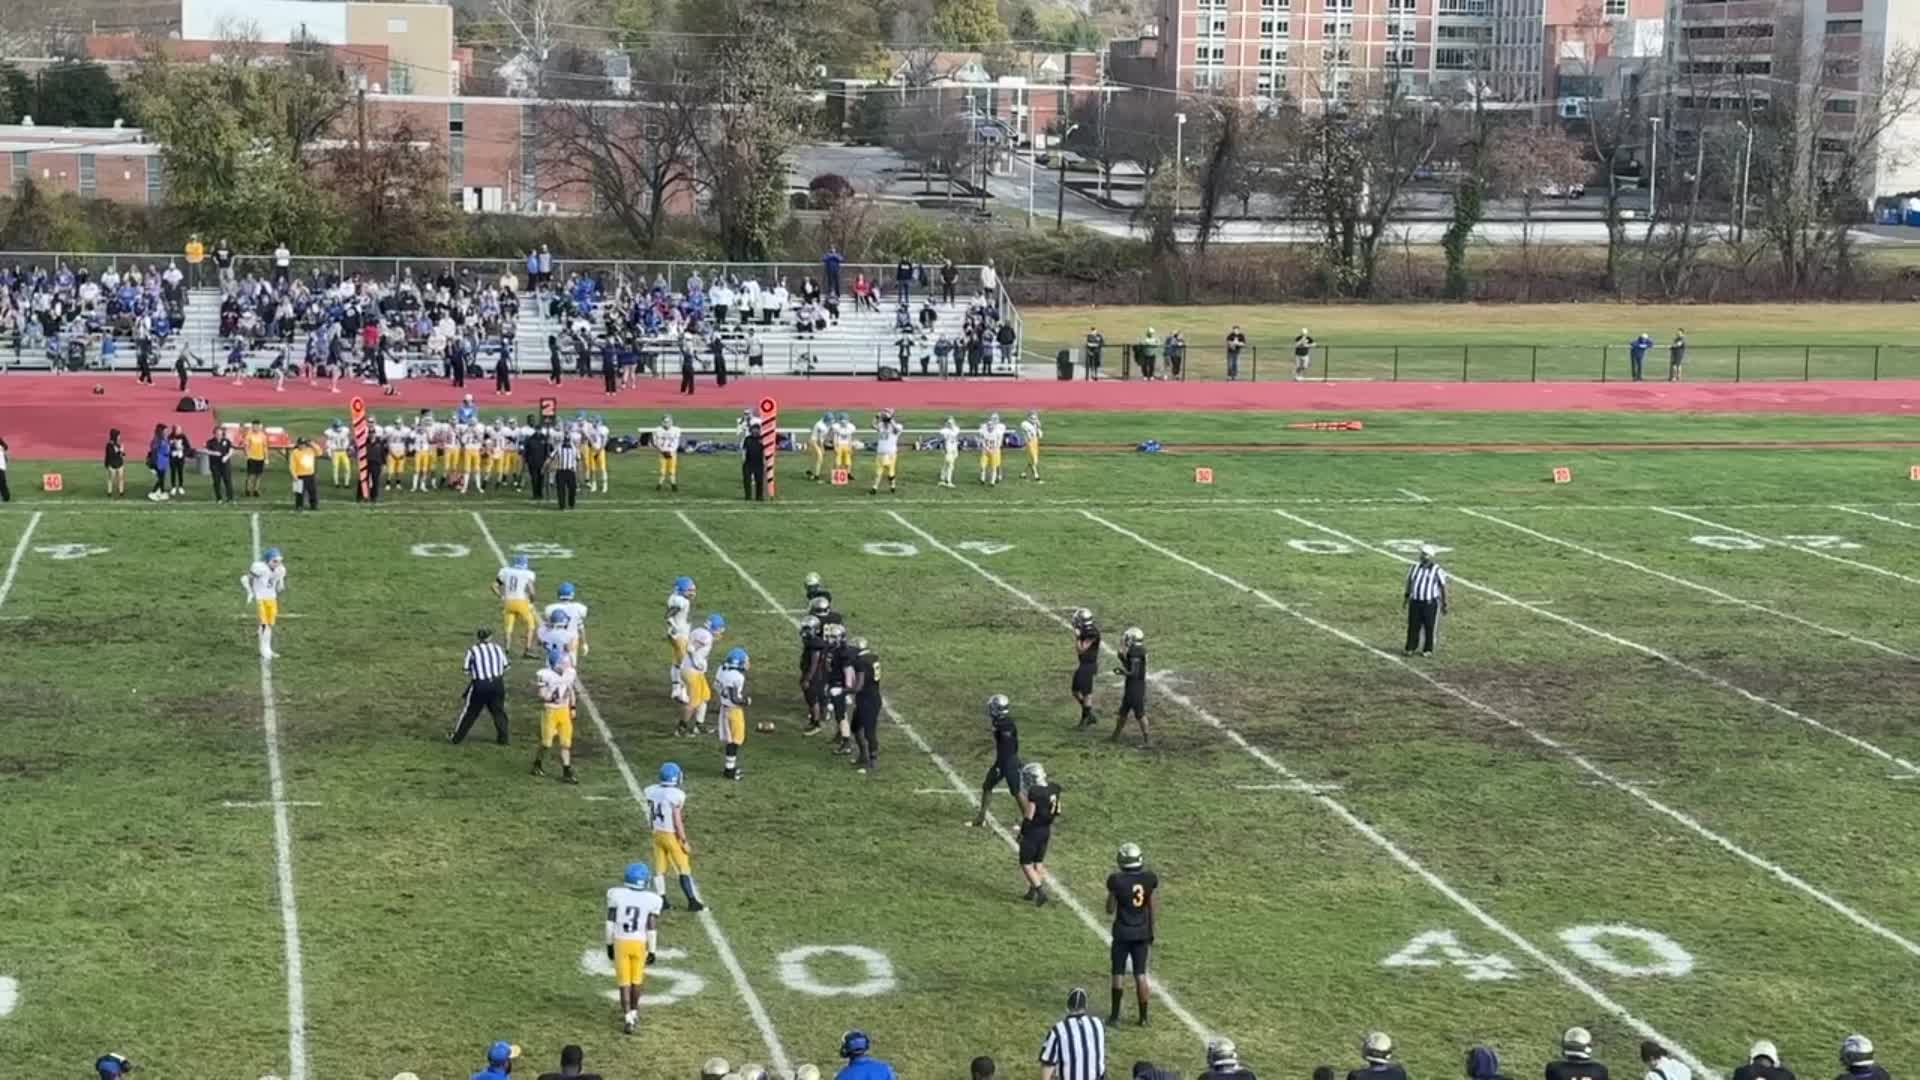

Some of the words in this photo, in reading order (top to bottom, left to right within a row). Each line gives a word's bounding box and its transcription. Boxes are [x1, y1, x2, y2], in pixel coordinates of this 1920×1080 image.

[45, 475, 60, 488] 40
[833, 471, 847, 483] 40
[1132, 884, 1145, 908] 3
[623, 906, 640, 933] 3
